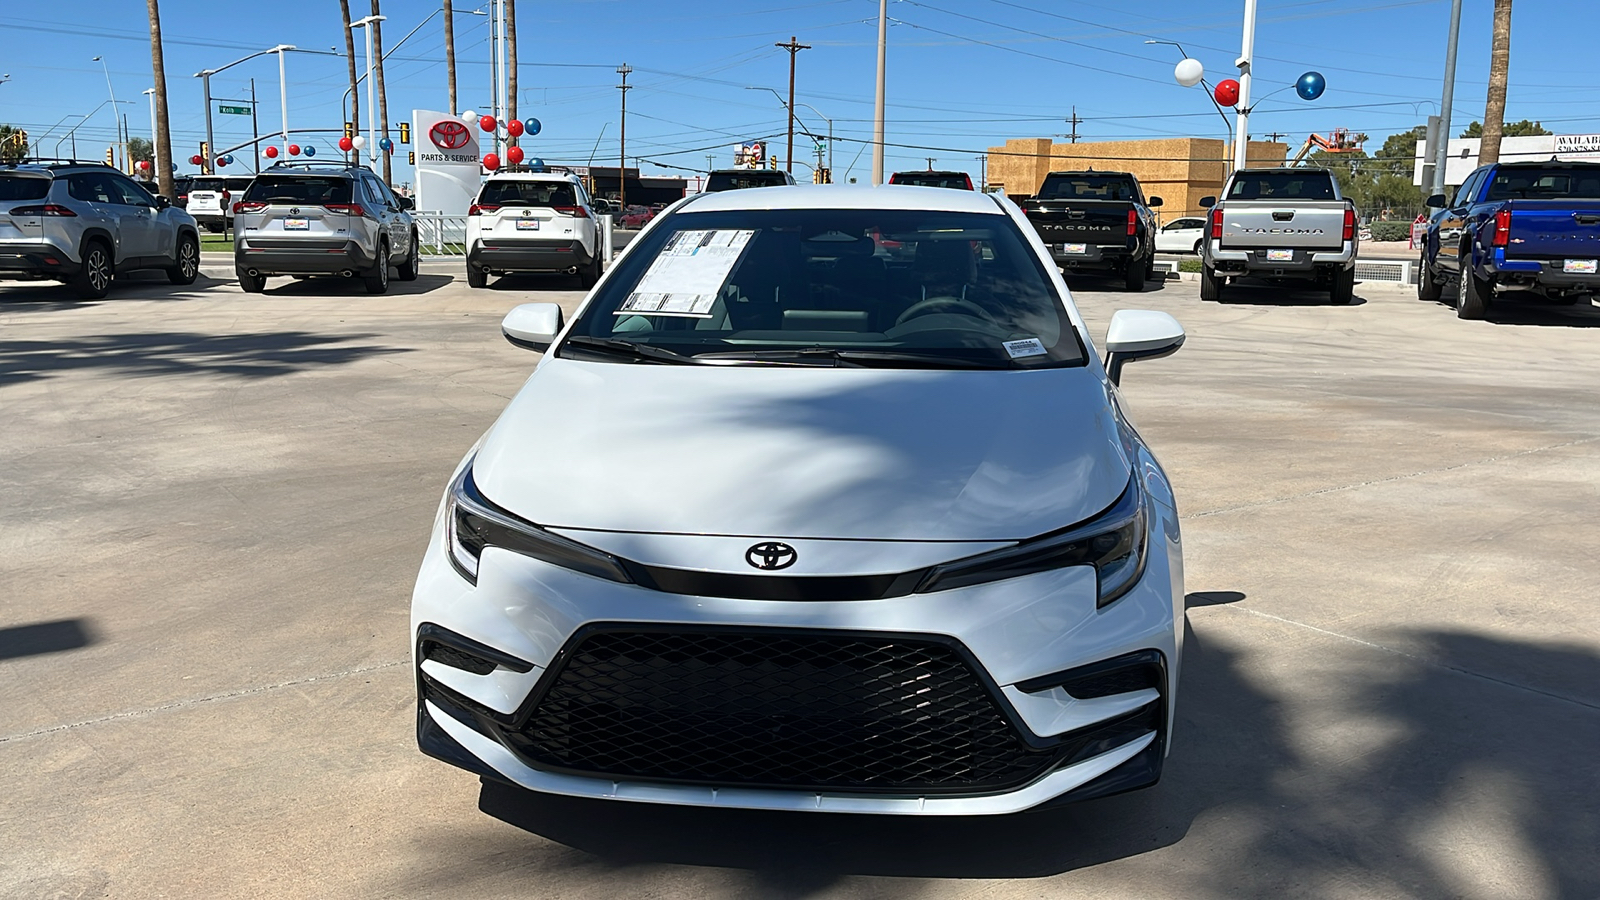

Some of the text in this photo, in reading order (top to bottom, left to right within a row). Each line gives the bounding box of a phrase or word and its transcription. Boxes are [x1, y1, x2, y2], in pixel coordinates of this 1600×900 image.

[1557, 136, 1600, 145] AVAILAB
[421, 153, 478, 162] PARTS & SERVICE
